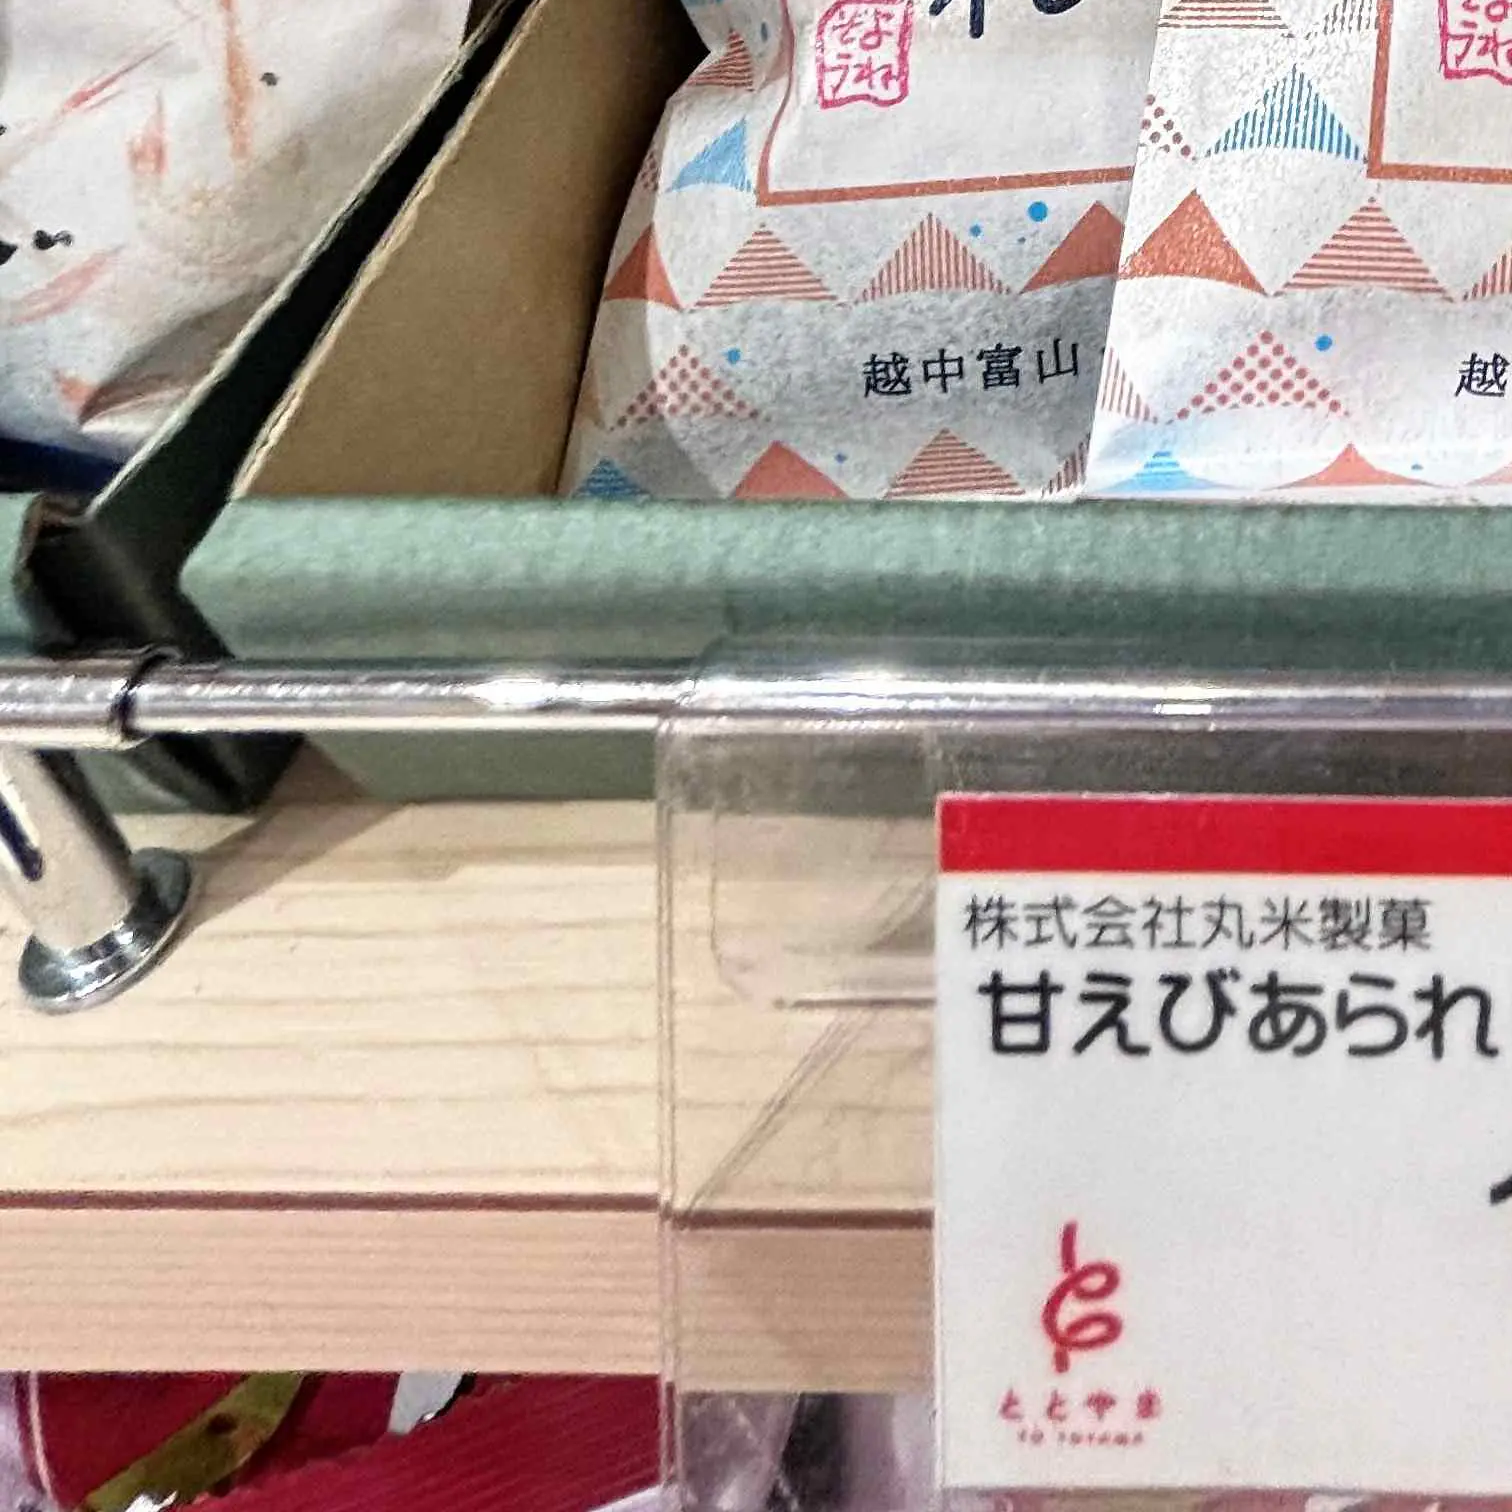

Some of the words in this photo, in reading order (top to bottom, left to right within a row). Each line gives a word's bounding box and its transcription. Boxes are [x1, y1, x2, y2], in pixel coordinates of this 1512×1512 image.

[863, 338, 1079, 399] 越中富山
[963, 896, 1430, 950] 株式会社丸米製菓
